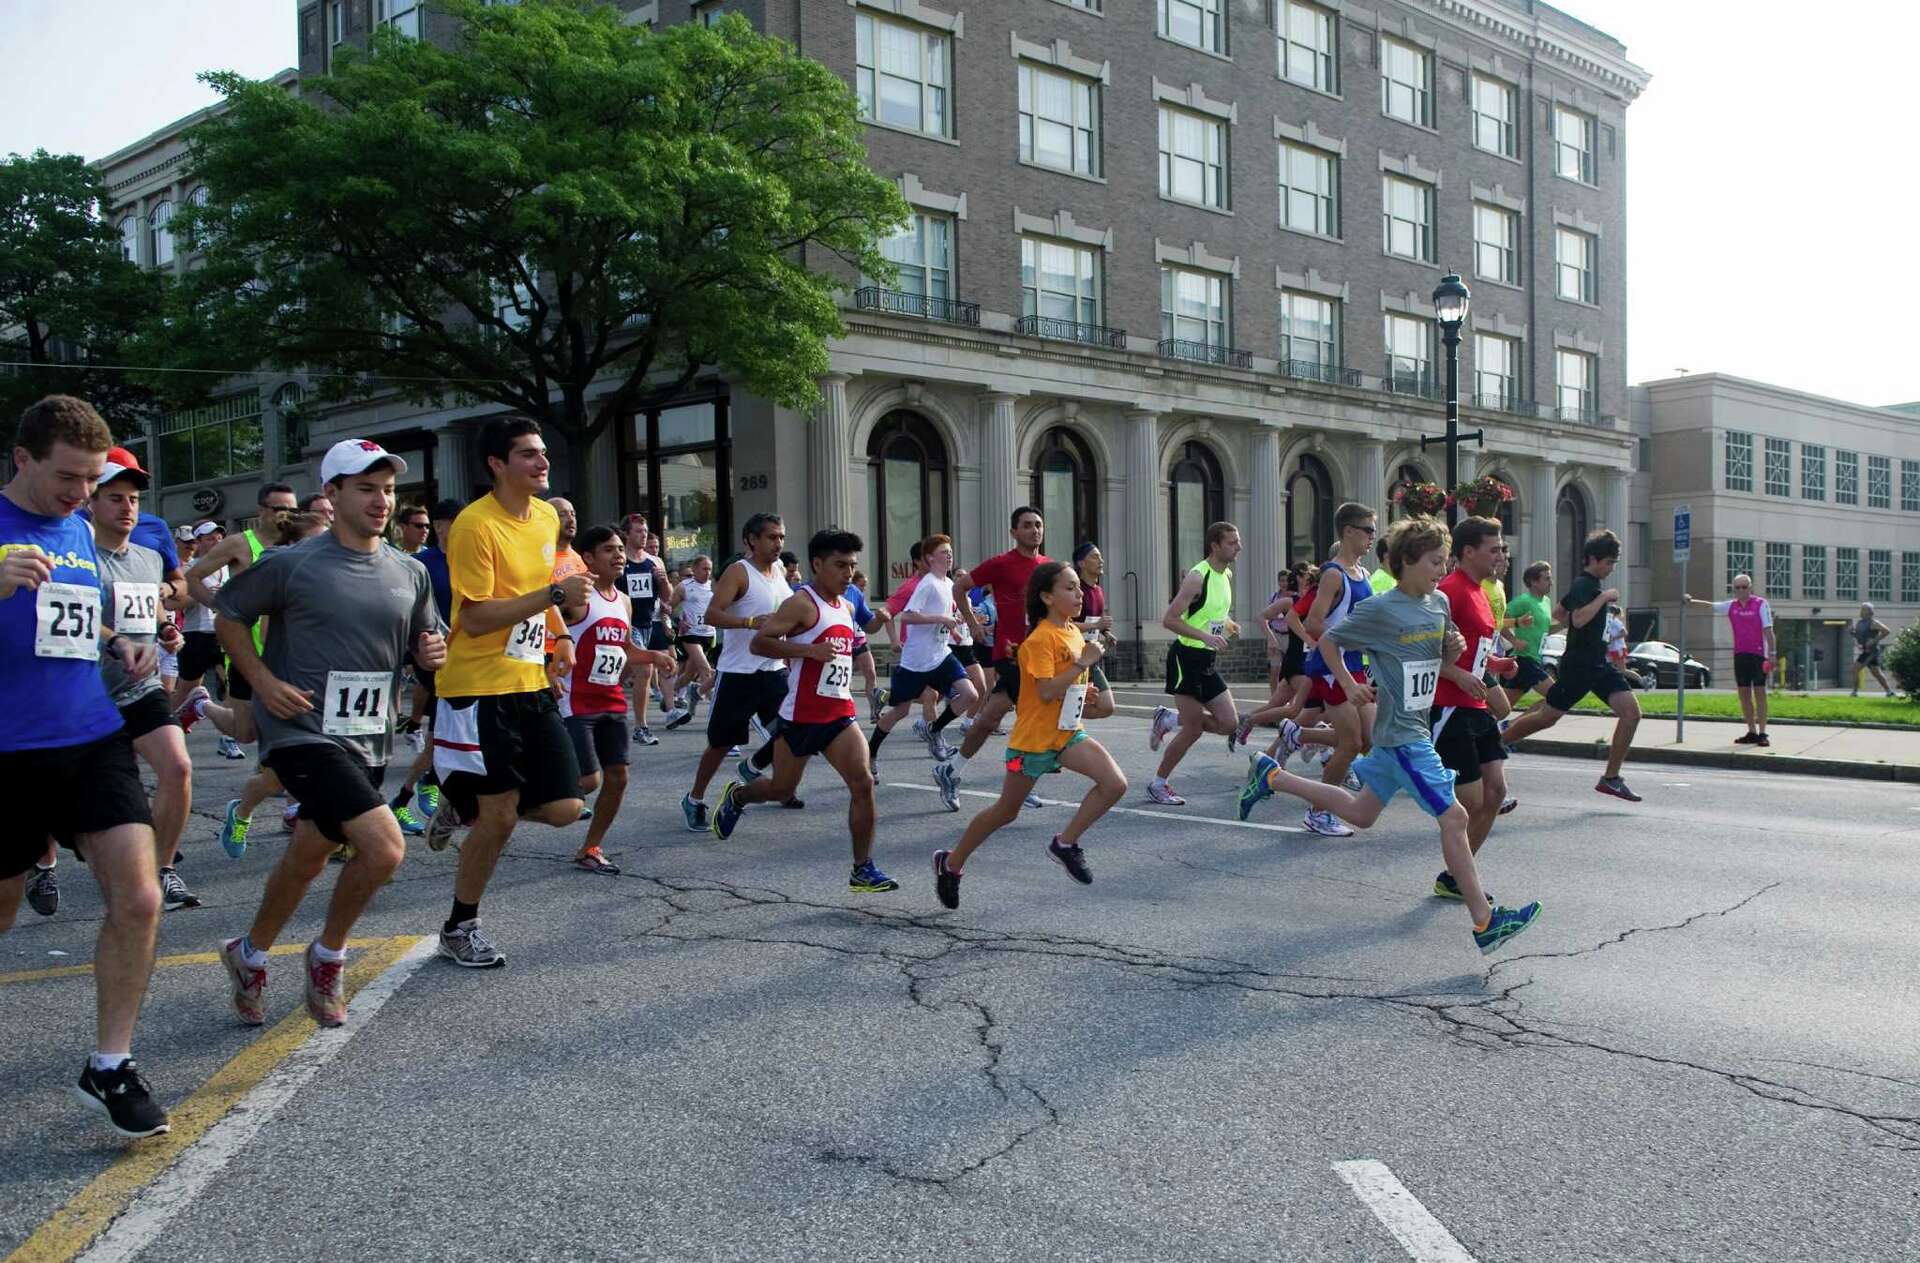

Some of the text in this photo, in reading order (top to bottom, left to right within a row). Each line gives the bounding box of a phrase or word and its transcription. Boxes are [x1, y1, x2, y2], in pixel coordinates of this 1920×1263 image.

[740, 474, 768, 491] 289
[631, 579, 650, 592] 214
[123, 595, 155, 619] 218
[50, 601, 94, 640] 251
[516, 620, 544, 649] 345
[598, 655, 623, 675] 234
[826, 664, 850, 688] 235
[1411, 671, 1436, 697] 103
[336, 687, 381, 717] 141
